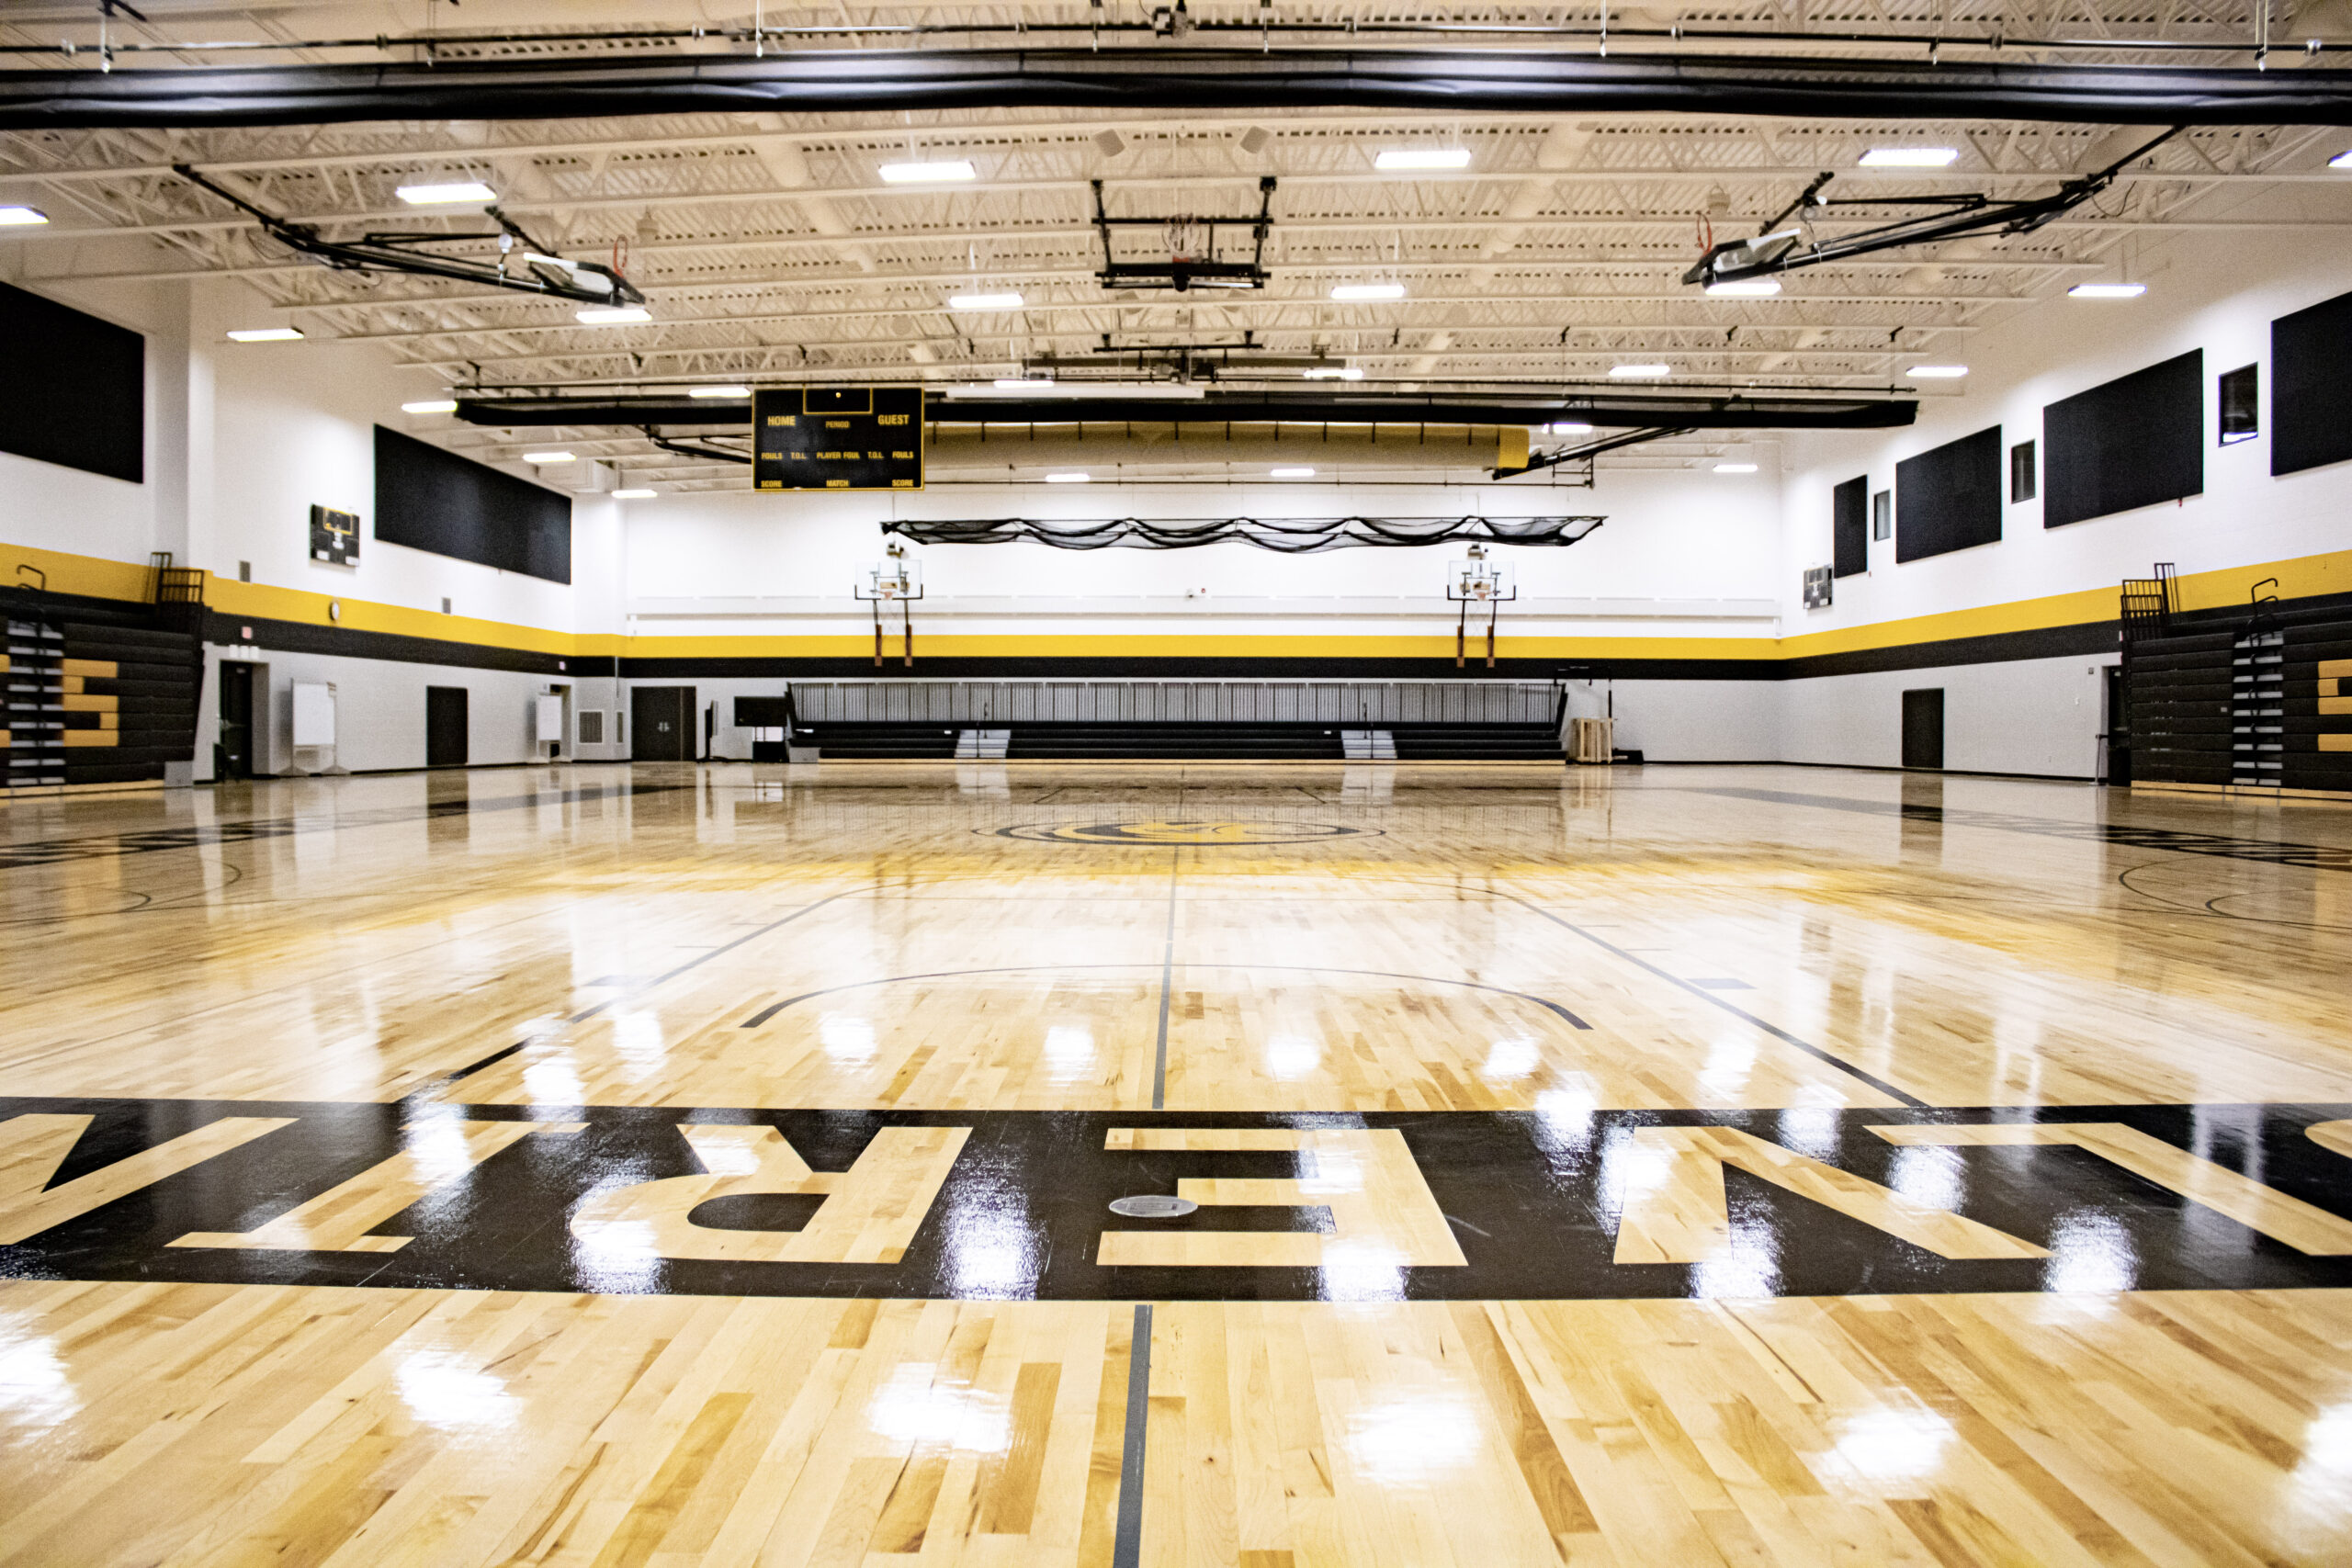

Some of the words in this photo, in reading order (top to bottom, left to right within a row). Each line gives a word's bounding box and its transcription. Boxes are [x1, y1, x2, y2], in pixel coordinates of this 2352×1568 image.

[767, 415, 797, 426] HOME
[877, 414, 910, 425] GUEST
[825, 421, 850, 429] PERIOD
[761, 452, 783, 460] FOULS
[816, 451, 842, 459] PLAYER
[842, 451, 860, 459] FOUL
[892, 451, 914, 459] FOULS
[761, 479, 783, 488] SCORE
[891, 479, 914, 487] SCORE
